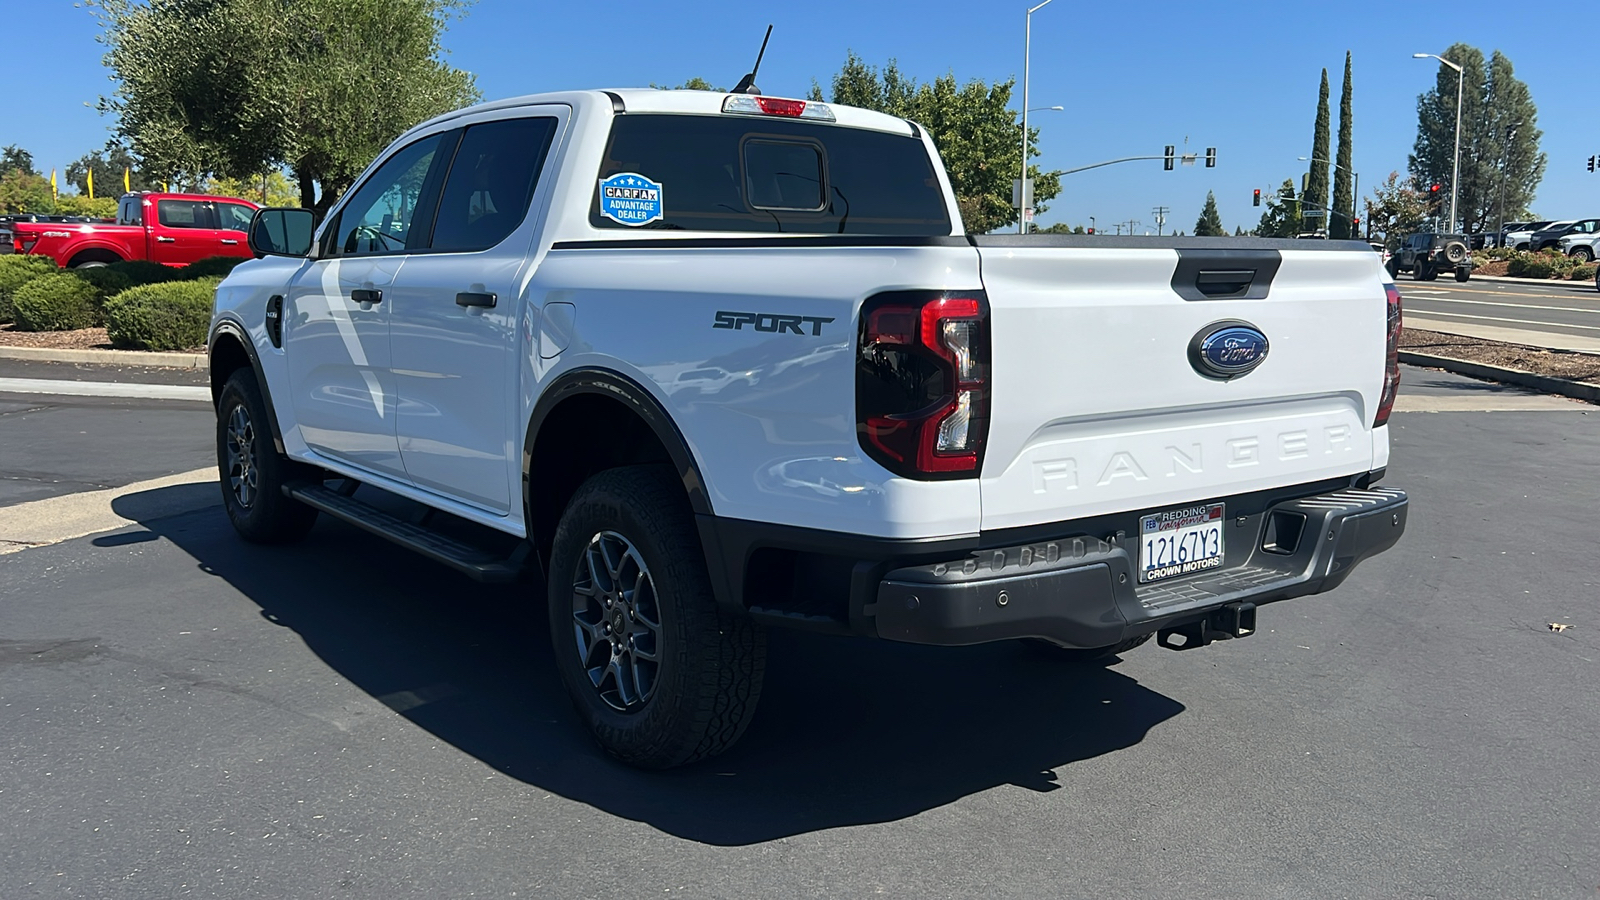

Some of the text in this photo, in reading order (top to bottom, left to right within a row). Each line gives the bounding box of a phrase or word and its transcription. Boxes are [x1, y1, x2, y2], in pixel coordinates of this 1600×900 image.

[605, 187, 657, 201] CARFAX
[610, 200, 654, 211] ADVANTAGE
[618, 210, 647, 220] DEALER
[712, 310, 836, 337] SPORT
[1220, 337, 1256, 362] Ford
[1032, 422, 1353, 495] RANGER
[1162, 506, 1206, 521] REDDING
[1145, 519, 1157, 530] FEB
[1147, 528, 1219, 570] 12167Y3
[1147, 556, 1220, 580] CROWN MOTORS
